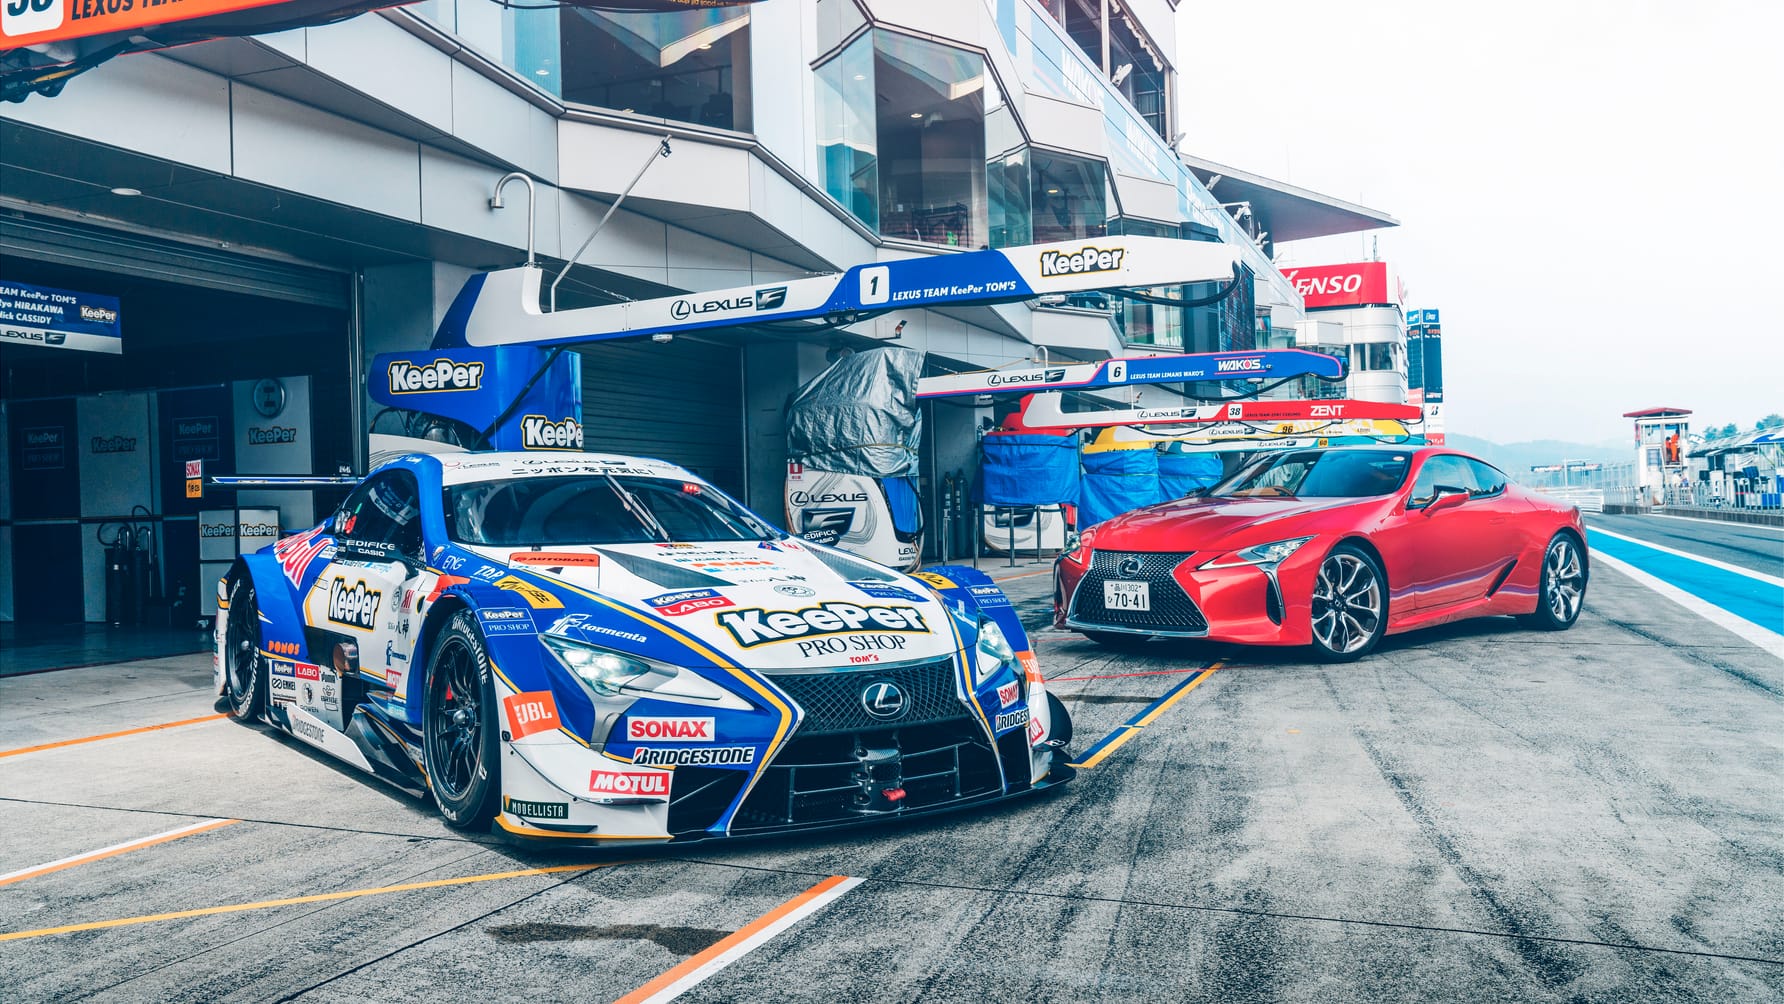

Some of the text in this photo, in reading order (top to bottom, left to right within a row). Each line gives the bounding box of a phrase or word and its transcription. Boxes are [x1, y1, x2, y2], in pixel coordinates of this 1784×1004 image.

[1041, 247, 1123, 276] KeePer
[870, 276, 879, 296] 1
[892, 280, 1016, 301] LEXUS TEAM KeePer TOM'S
[1290, 270, 1362, 297] ENSO
[20, 290, 49, 301] KeePer
[51, 294, 77, 304] TOM'S
[14, 301, 64, 315] HIRAKAWA
[692, 296, 753, 314] LEXUS
[16, 313, 52, 325] CASSIDY
[81, 306, 116, 321] KeePer
[390, 361, 482, 391] KeePer
[1002, 373, 1043, 383] LEXUS
[1113, 366, 1122, 378] 6
[1130, 372, 1146, 380] LEXUS
[1147, 410, 1180, 419] LEXUS
[1229, 407, 1241, 416] 38
[1310, 404, 1345, 417] ZENT
[249, 427, 296, 444] KeePer
[1282, 425, 1293, 434] 96
[811, 493, 869, 503] LEXUS
[201, 525, 235, 537] KeePer
[239, 524, 278, 537] KeePer
[346, 540, 396, 551] EDIFICE
[357, 548, 385, 557] CASIO
[331, 577, 381, 630] KeePer
[651, 590, 713, 606] KeePer
[1114, 592, 1146, 609] 70-41
[664, 598, 726, 616] LABO
[482, 610, 525, 620] KeePer
[488, 623, 530, 632] PRO SHOP
[720, 602, 929, 645] KeePer
[268, 641, 300, 656] PONOS
[796, 634, 907, 658] PRO SHOP
[849, 653, 880, 663] TOM'S
[297, 667, 318, 677] LABO
[514, 702, 552, 725] JBL
[630, 720, 708, 738] SONAX
[632, 747, 755, 765] BRIDGESTONE
[592, 773, 666, 793] MOTUL
[511, 801, 564, 818] MODELLISTA
